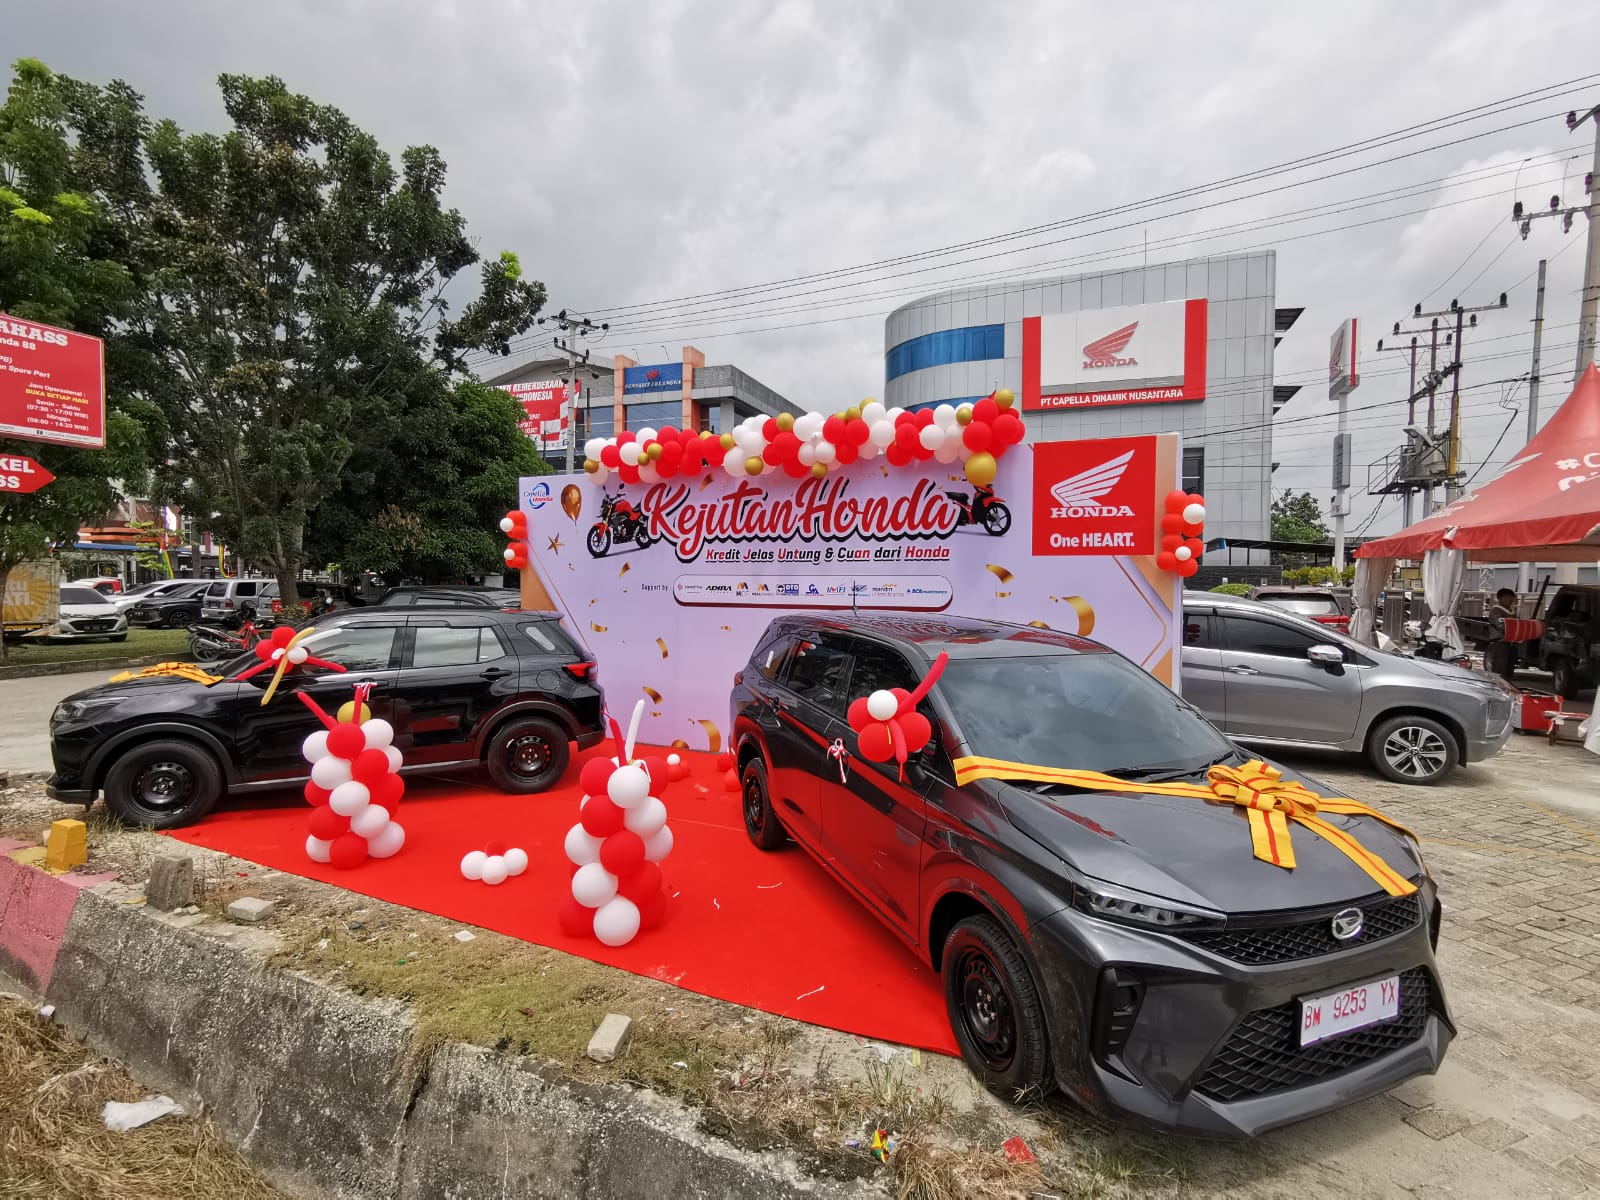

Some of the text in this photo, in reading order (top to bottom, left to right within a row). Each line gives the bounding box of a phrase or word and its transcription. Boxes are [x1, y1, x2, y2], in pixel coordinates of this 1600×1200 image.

[22, 340, 36, 351] 88
[1082, 357, 1138, 369] HONDA
[8, 365, 32, 375] Spare
[33, 369, 50, 379] Part
[25, 388, 46, 397] BUKA
[46, 392, 72, 401] SETIAP
[28, 382, 44, 390] Jam
[44, 385, 83, 397] Operasional
[35, 399, 55, 407] Senin
[1040, 389, 1184, 406] PT CAPELLA DINAMIK NUSANTARA
[46, 413, 71, 423] Minggu
[55, 408, 73, 417] 17:00
[55, 421, 73, 429] 14:30
[0, 457, 35, 474] KEL
[1050, 505, 1136, 518] HONDA
[1050, 532, 1135, 548] One HEART.
[706, 545, 950, 563] Kredit Jelas Untung & Cuan dari Honda
[641, 584, 660, 592] Support
[1304, 981, 1396, 1030] BM 9253 YX
